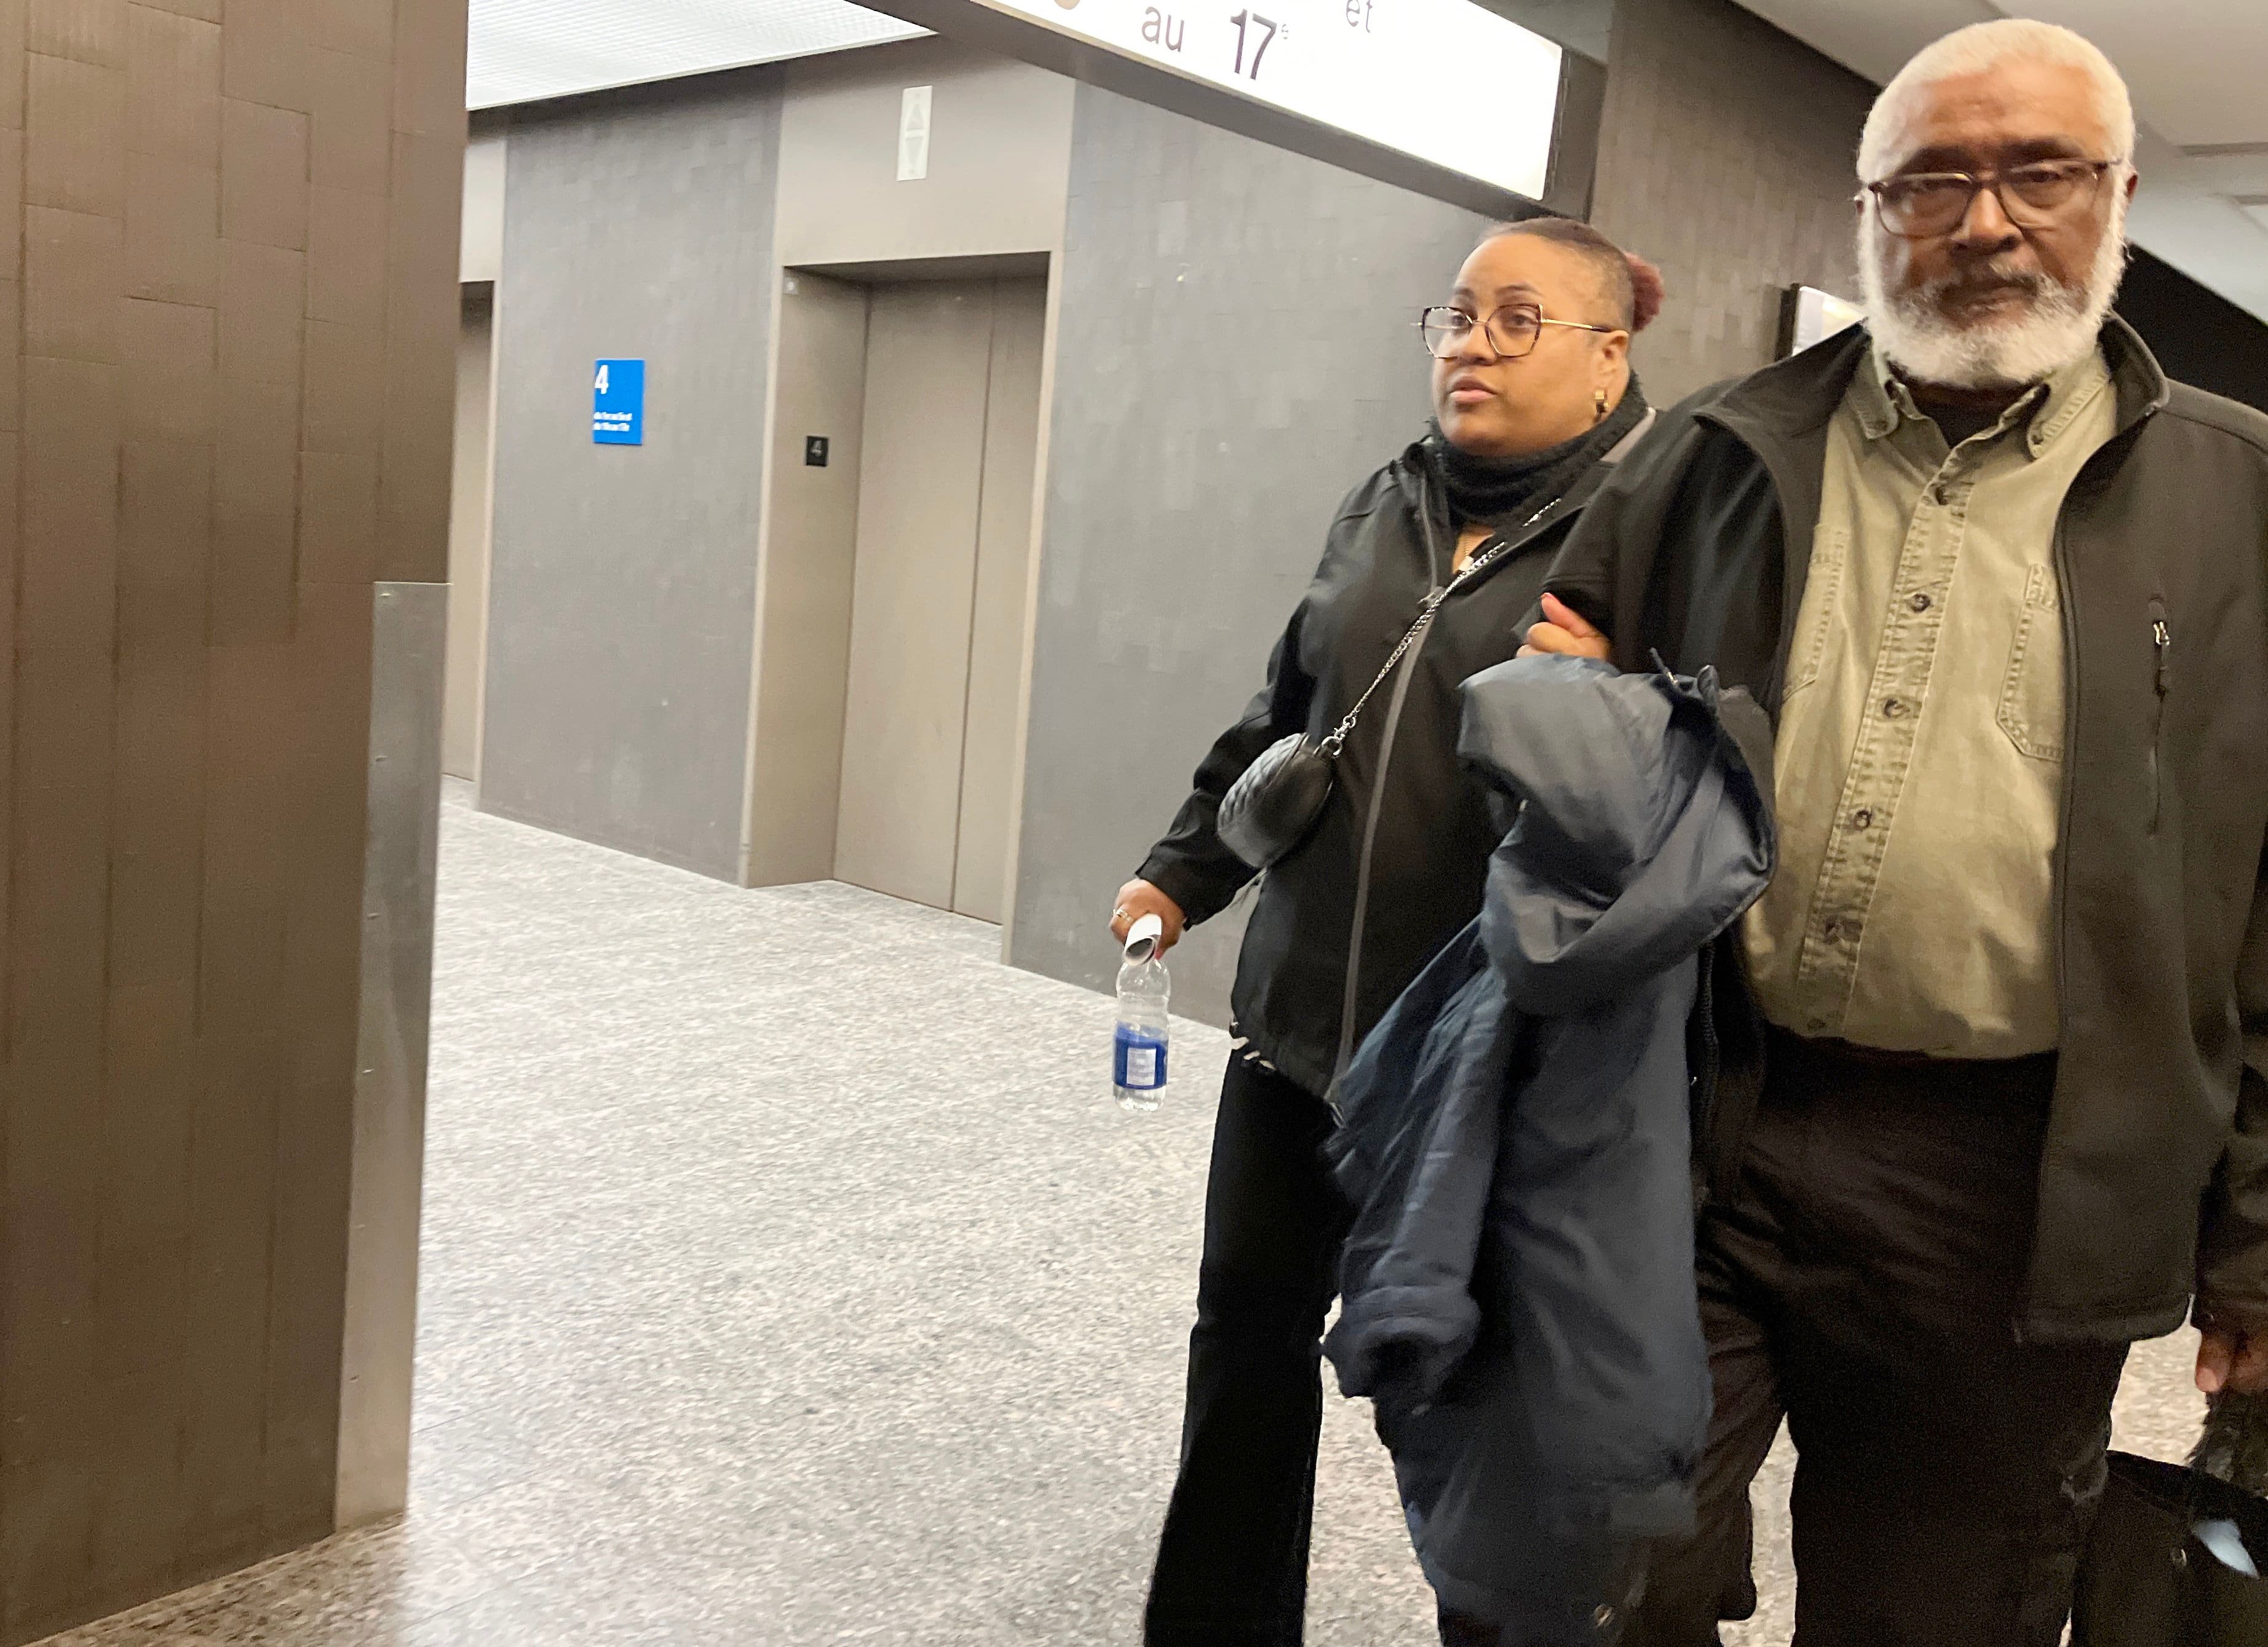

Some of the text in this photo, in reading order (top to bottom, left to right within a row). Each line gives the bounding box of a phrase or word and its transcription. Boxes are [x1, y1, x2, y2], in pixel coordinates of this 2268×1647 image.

[1141, 6, 1185, 52] au
[595, 364, 609, 395] 4
[811, 440, 822, 457] 4
